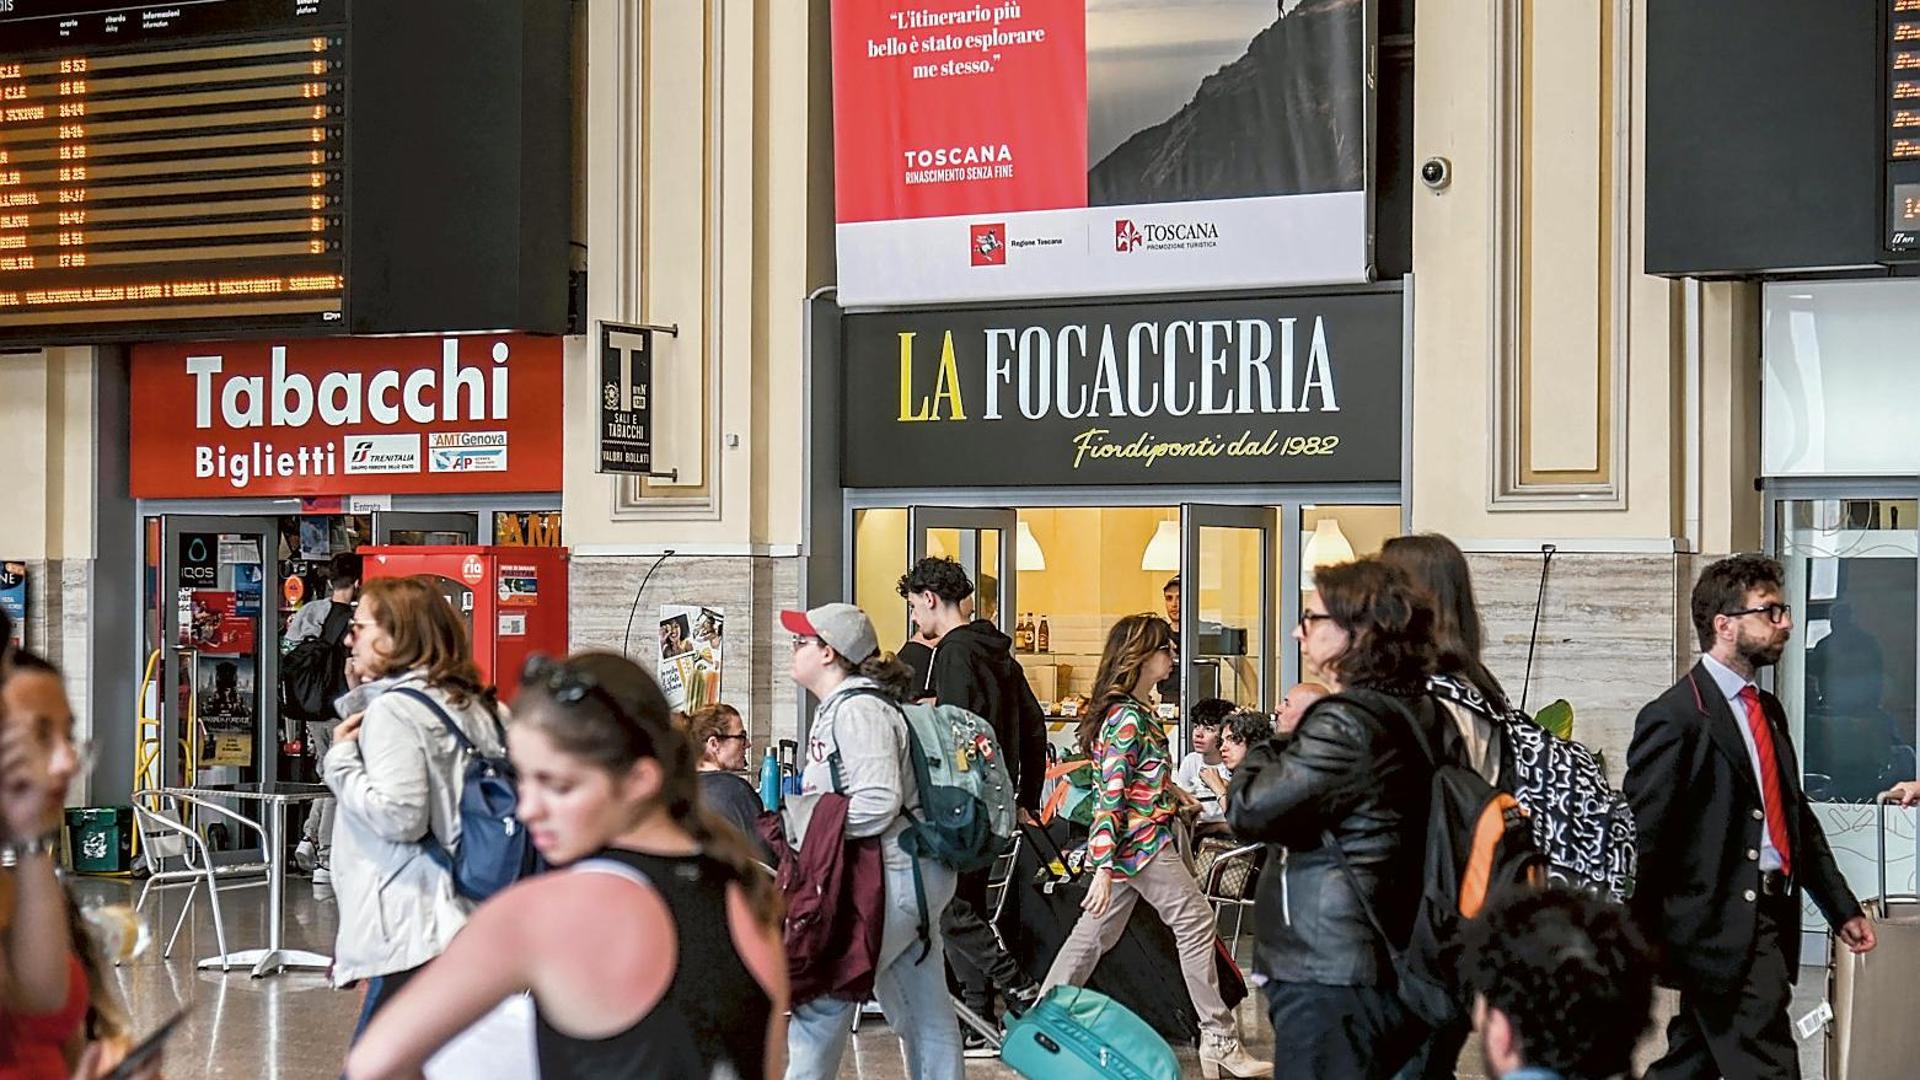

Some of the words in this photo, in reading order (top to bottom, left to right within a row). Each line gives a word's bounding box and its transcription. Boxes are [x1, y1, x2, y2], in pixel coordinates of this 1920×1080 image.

[993, 1, 1021, 25] più
[867, 37, 908, 58] bello
[909, 36, 920, 53] è
[921, 36, 962, 52] stato
[965, 28, 1045, 52] esplorare
[913, 64, 938, 79] me
[904, 144, 1012, 168] TOSCANA
[905, 167, 965, 185] RINASCIMENTO
[966, 165, 993, 181] SENZA
[994, 164, 1014, 178] FINE
[1011, 239, 1036, 248] Regione
[1037, 238, 1062, 246] Toscana
[1144, 223, 1218, 242] TOSCANA
[1146, 242, 1185, 250] PROMOZIONE
[1186, 241, 1217, 249] TURISTICA
[608, 331, 643, 412] T
[897, 330, 967, 422] LA
[983, 315, 1340, 421] FOCACCERIA
[186, 338, 509, 429] Tabacchi
[614, 413, 630, 424] SALI
[632, 414, 638, 425] E
[608, 423, 644, 440] TABACCHI
[370, 454, 415, 462] TRENITALIA
[602, 450, 623, 463] VALORI
[625, 451, 649, 465] BOLLATI
[1072, 428, 1226, 468] Fiordiponti
[1227, 430, 1280, 458] dal
[1281, 435, 1341, 456] 1982
[196, 442, 335, 487] Biglietti
